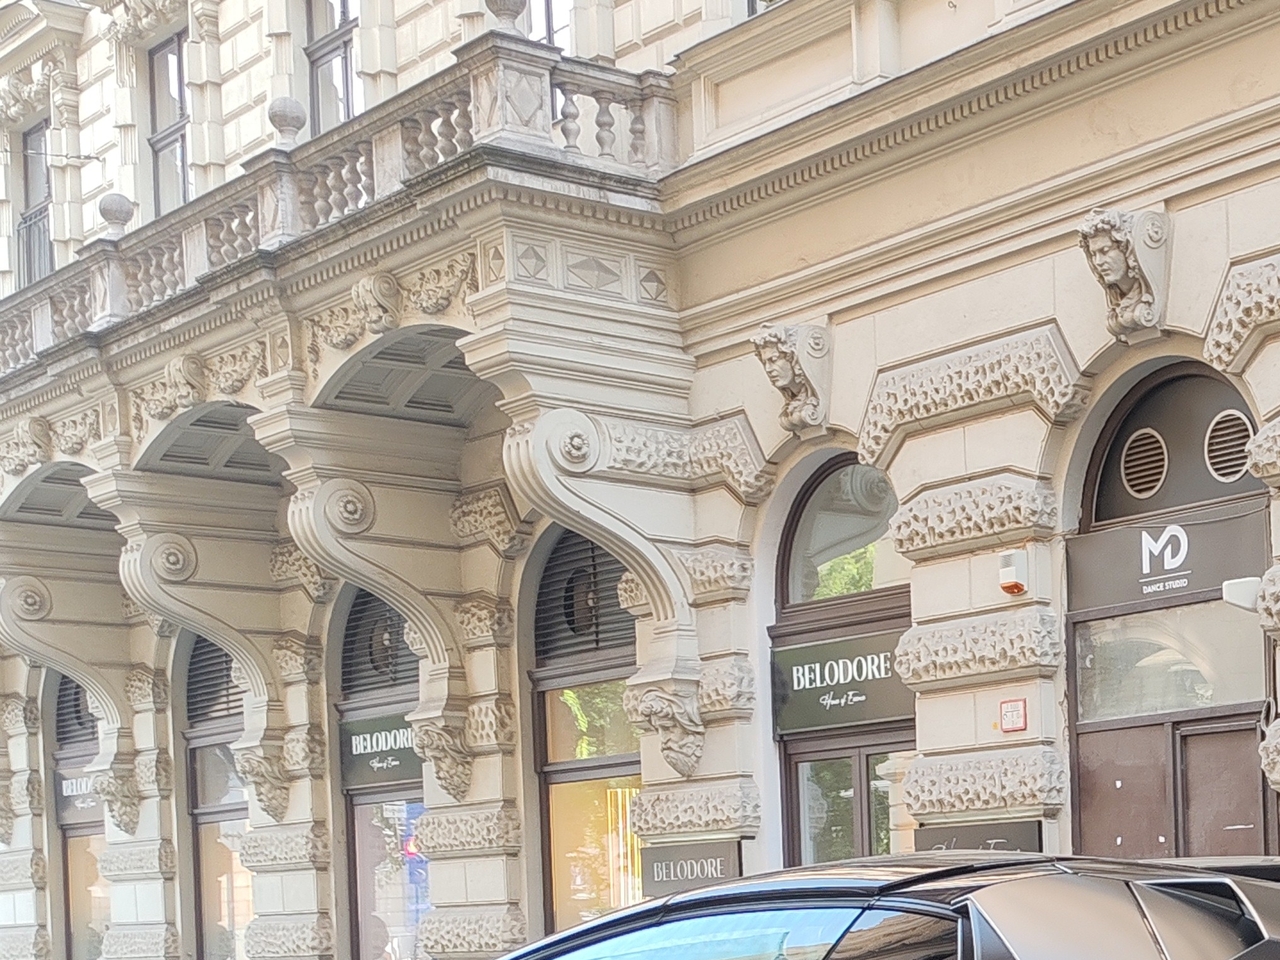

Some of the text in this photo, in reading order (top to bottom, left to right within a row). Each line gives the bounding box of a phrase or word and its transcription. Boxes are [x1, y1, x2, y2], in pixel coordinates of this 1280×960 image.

[1141, 525, 1189, 574] MD
[1142, 578, 1188, 594] DANCE STUDIO
[792, 652, 892, 691] BELODORE
[62, 777, 91, 797] BELOD
[653, 857, 726, 882] BELODORE
